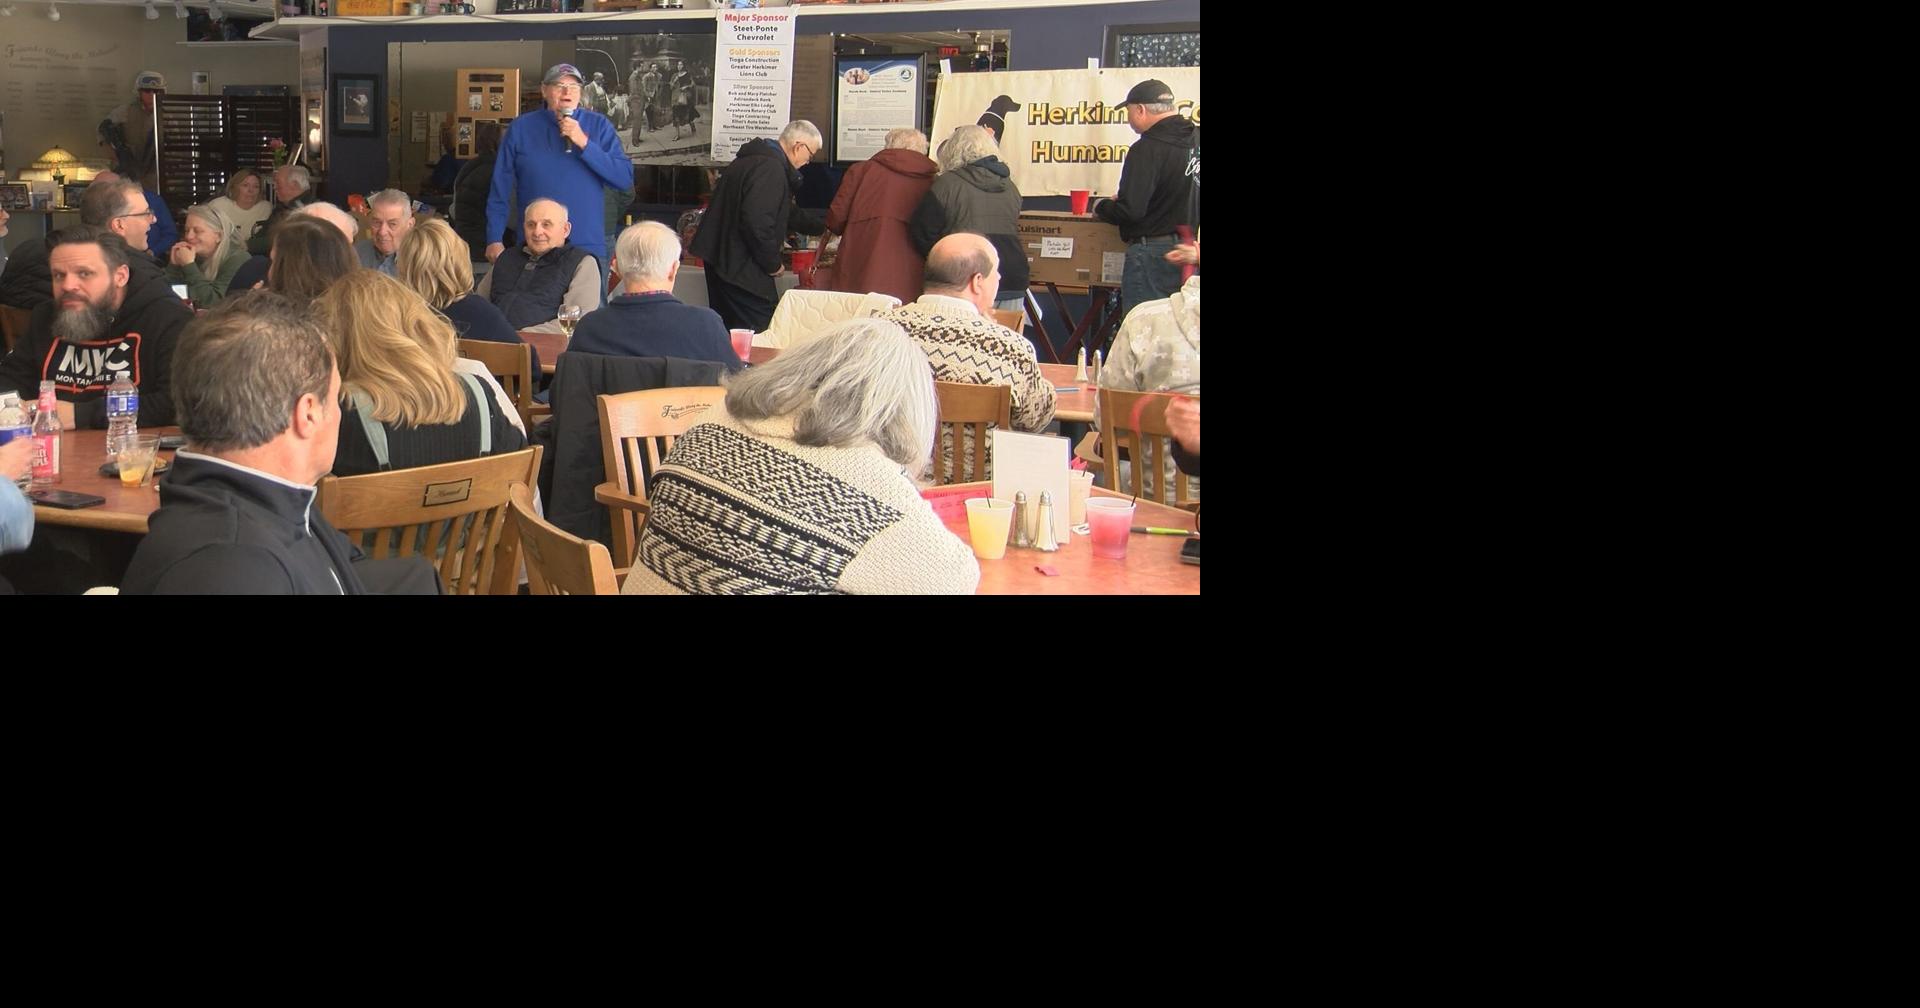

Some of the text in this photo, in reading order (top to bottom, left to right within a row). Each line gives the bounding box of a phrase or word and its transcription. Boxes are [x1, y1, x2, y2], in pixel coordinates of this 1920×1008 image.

[724, 14, 788, 23] Major Sponsor
[729, 48, 781, 57] Gold Sponsors
